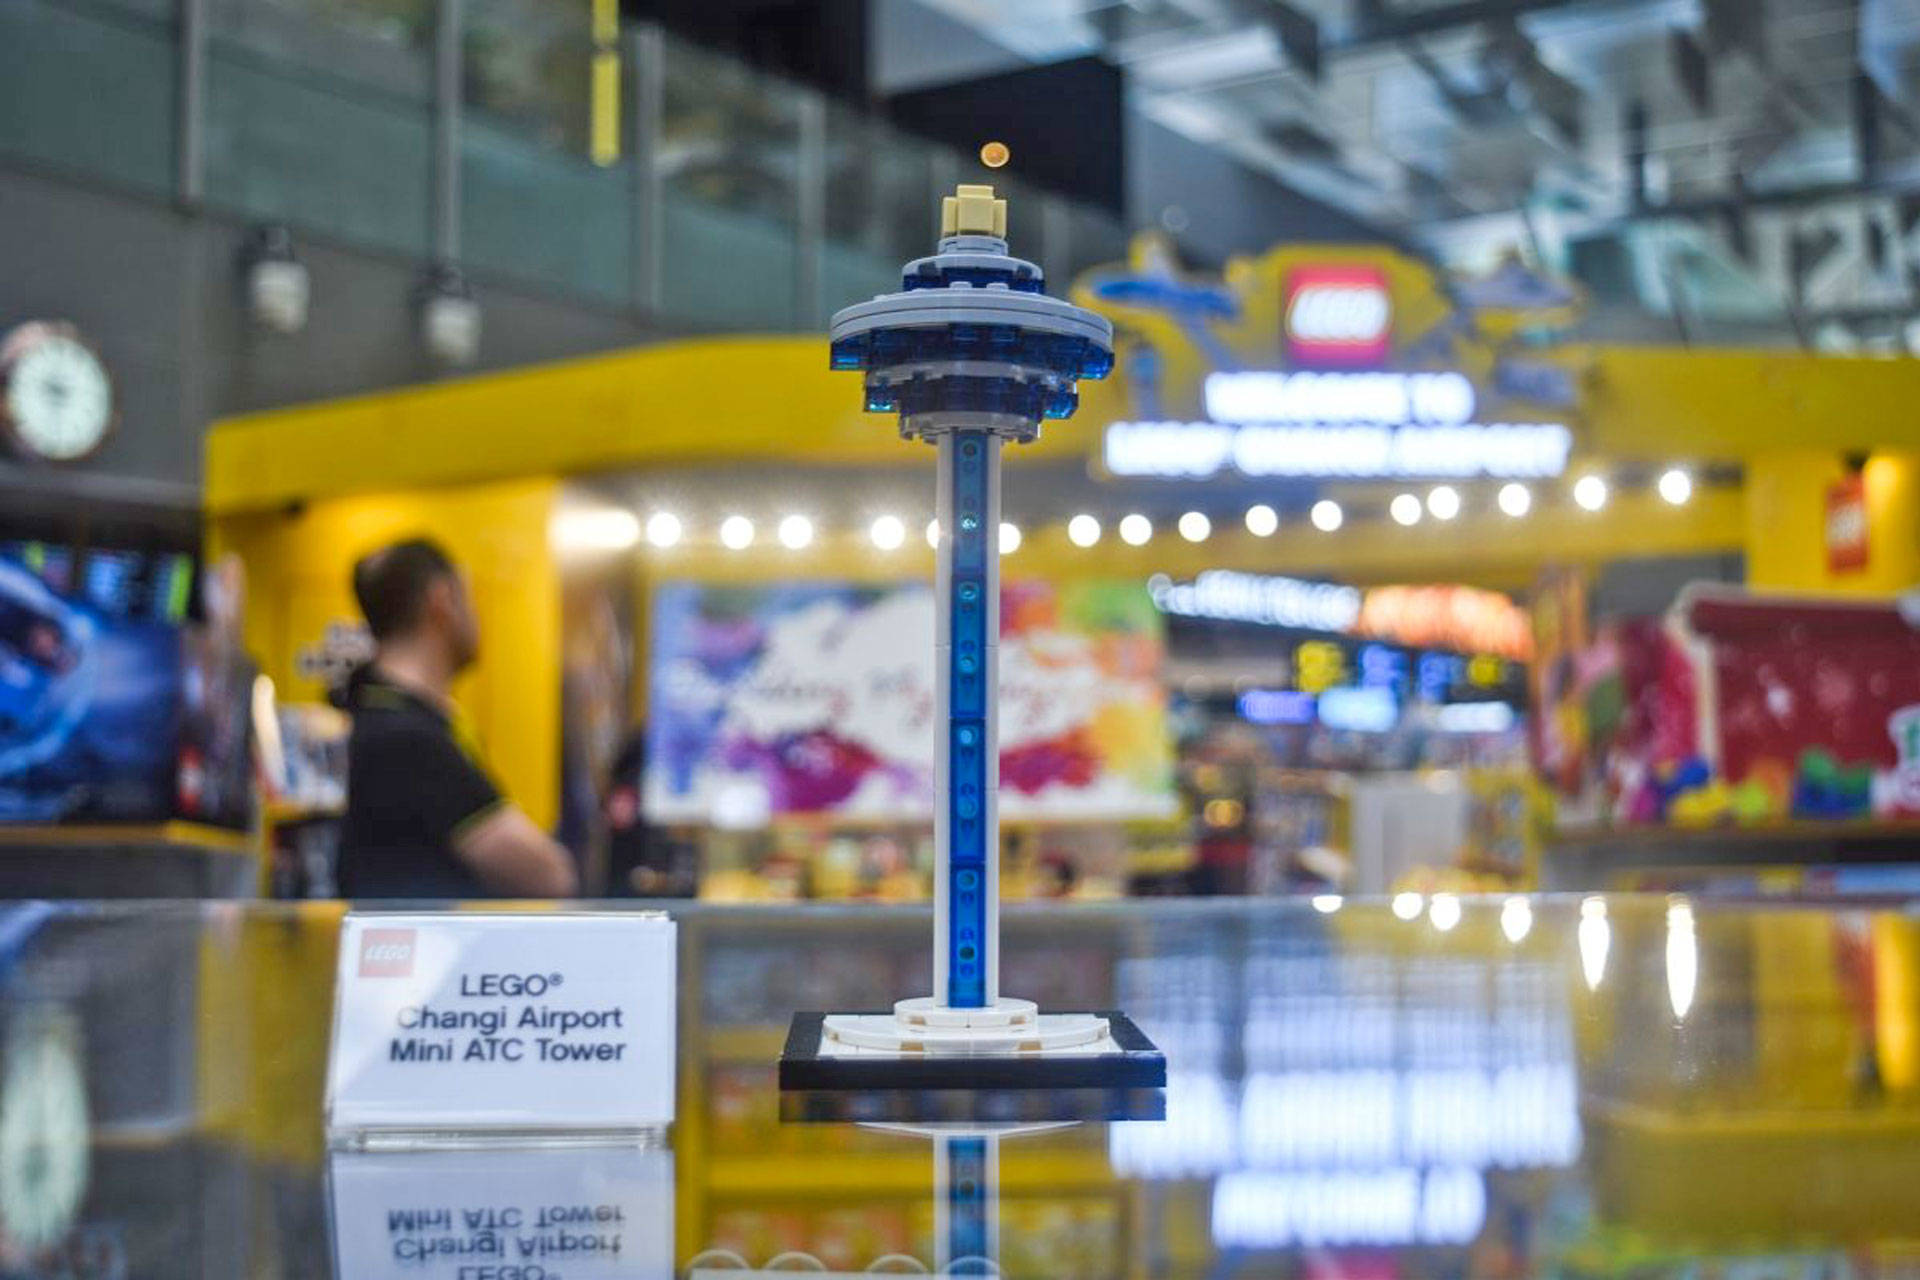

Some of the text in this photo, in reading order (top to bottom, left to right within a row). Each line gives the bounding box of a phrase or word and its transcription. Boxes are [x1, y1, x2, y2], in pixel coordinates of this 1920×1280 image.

[460, 973, 563, 997] LEGO®
[397, 1006, 623, 1036] Changi Airport
[390, 1037, 627, 1061] Mini ATC Tower
